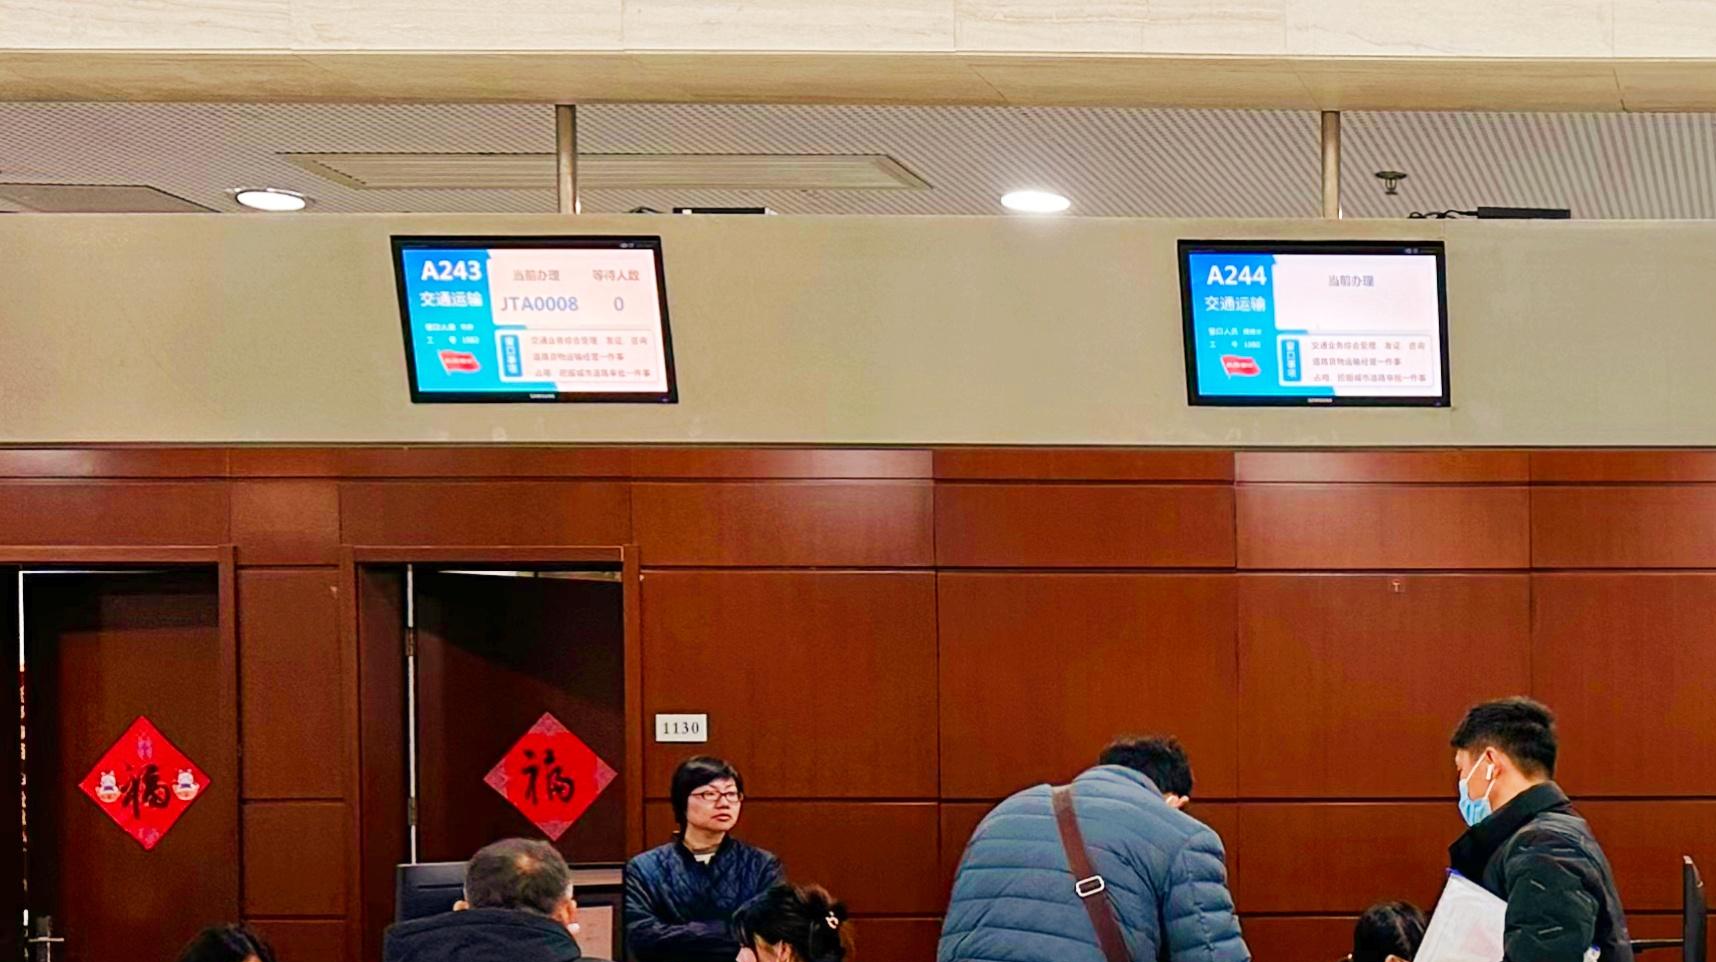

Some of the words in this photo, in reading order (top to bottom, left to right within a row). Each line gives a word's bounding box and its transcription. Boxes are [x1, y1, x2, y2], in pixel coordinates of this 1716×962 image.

[421, 260, 482, 281] A243
[513, 269, 560, 281] 当前办理
[592, 269, 640, 281] 等待人数
[1206, 265, 1267, 286] A244
[1328, 274, 1374, 287] 当前办理
[419, 291, 483, 307] 交通运输
[500, 296, 579, 312] JTA0008
[613, 296, 625, 312] 0
[1205, 296, 1266, 312] 交通运输
[663, 720, 699, 735] 1130
[521, 747, 575, 806] 福
[119, 763, 171, 820] 福
